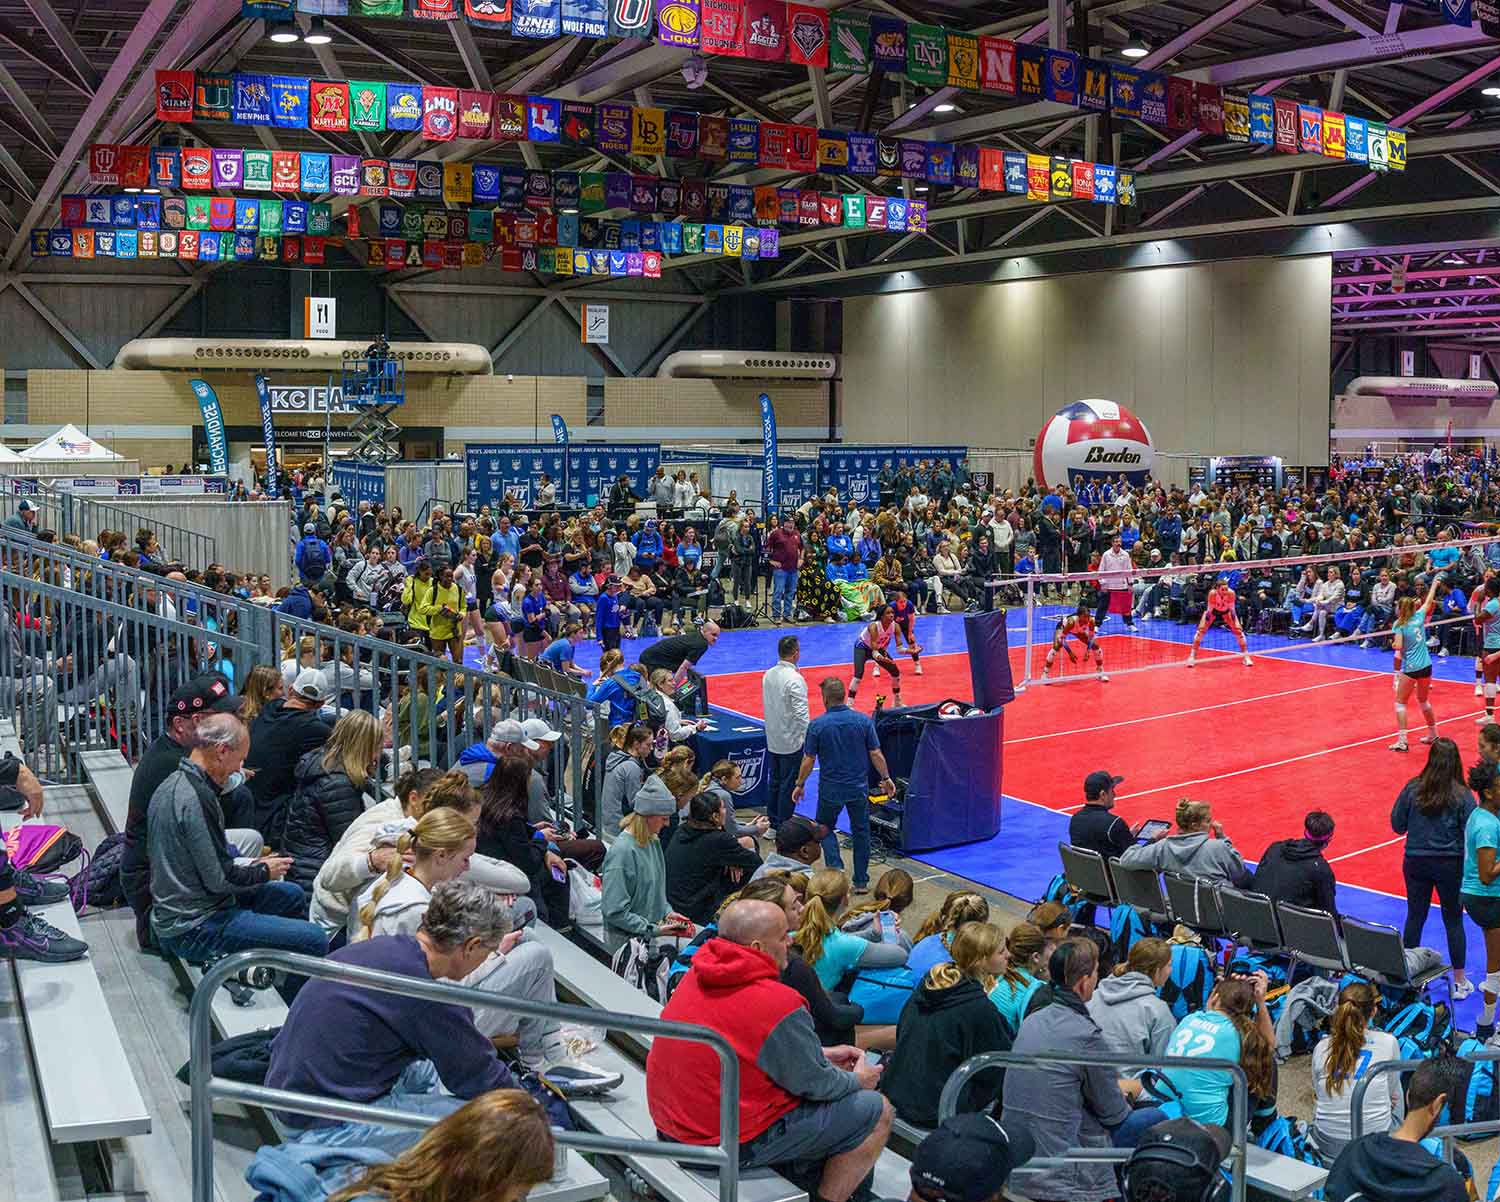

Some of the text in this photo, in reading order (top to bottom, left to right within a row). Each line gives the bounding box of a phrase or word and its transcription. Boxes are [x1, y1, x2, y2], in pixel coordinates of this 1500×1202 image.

[517, 16, 556, 29] UNH
[563, 19, 606, 36] WOLF PACK
[660, 33, 699, 45] LIONS
[750, 32, 779, 45] AGGIES
[874, 44, 905, 57] NAU
[985, 49, 1013, 84] N
[196, 86, 230, 109] U
[425, 97, 455, 114] LMU
[1142, 105, 1167, 117] STATE
[236, 112, 271, 121] MEMPHIS
[602, 108, 629, 119] LSU
[1277, 109, 1295, 131] M
[313, 116, 347, 127] MARYLAND
[500, 123, 522, 132] ULM
[1302, 119, 1321, 141] M
[600, 141, 628, 151] TIGERS
[1388, 140, 1407, 160] M
[333, 175, 358, 185] GCU
[1075, 179, 1092, 187] IONA
[848, 197, 861, 218] E
[870, 206, 885, 220] E
[800, 217, 819, 225] ELON
[451, 219, 465, 237] C
[405, 244, 423, 265] A
[271, 388, 307, 409] KC
[1084, 446, 1142, 465] Baden
[505, 487, 529, 499] NIT
[850, 482, 868, 492] NIT
[783, 494, 801, 505] NIT
[1413, 626, 1423, 641] 3
[1167, 1027, 1215, 1057] 32
